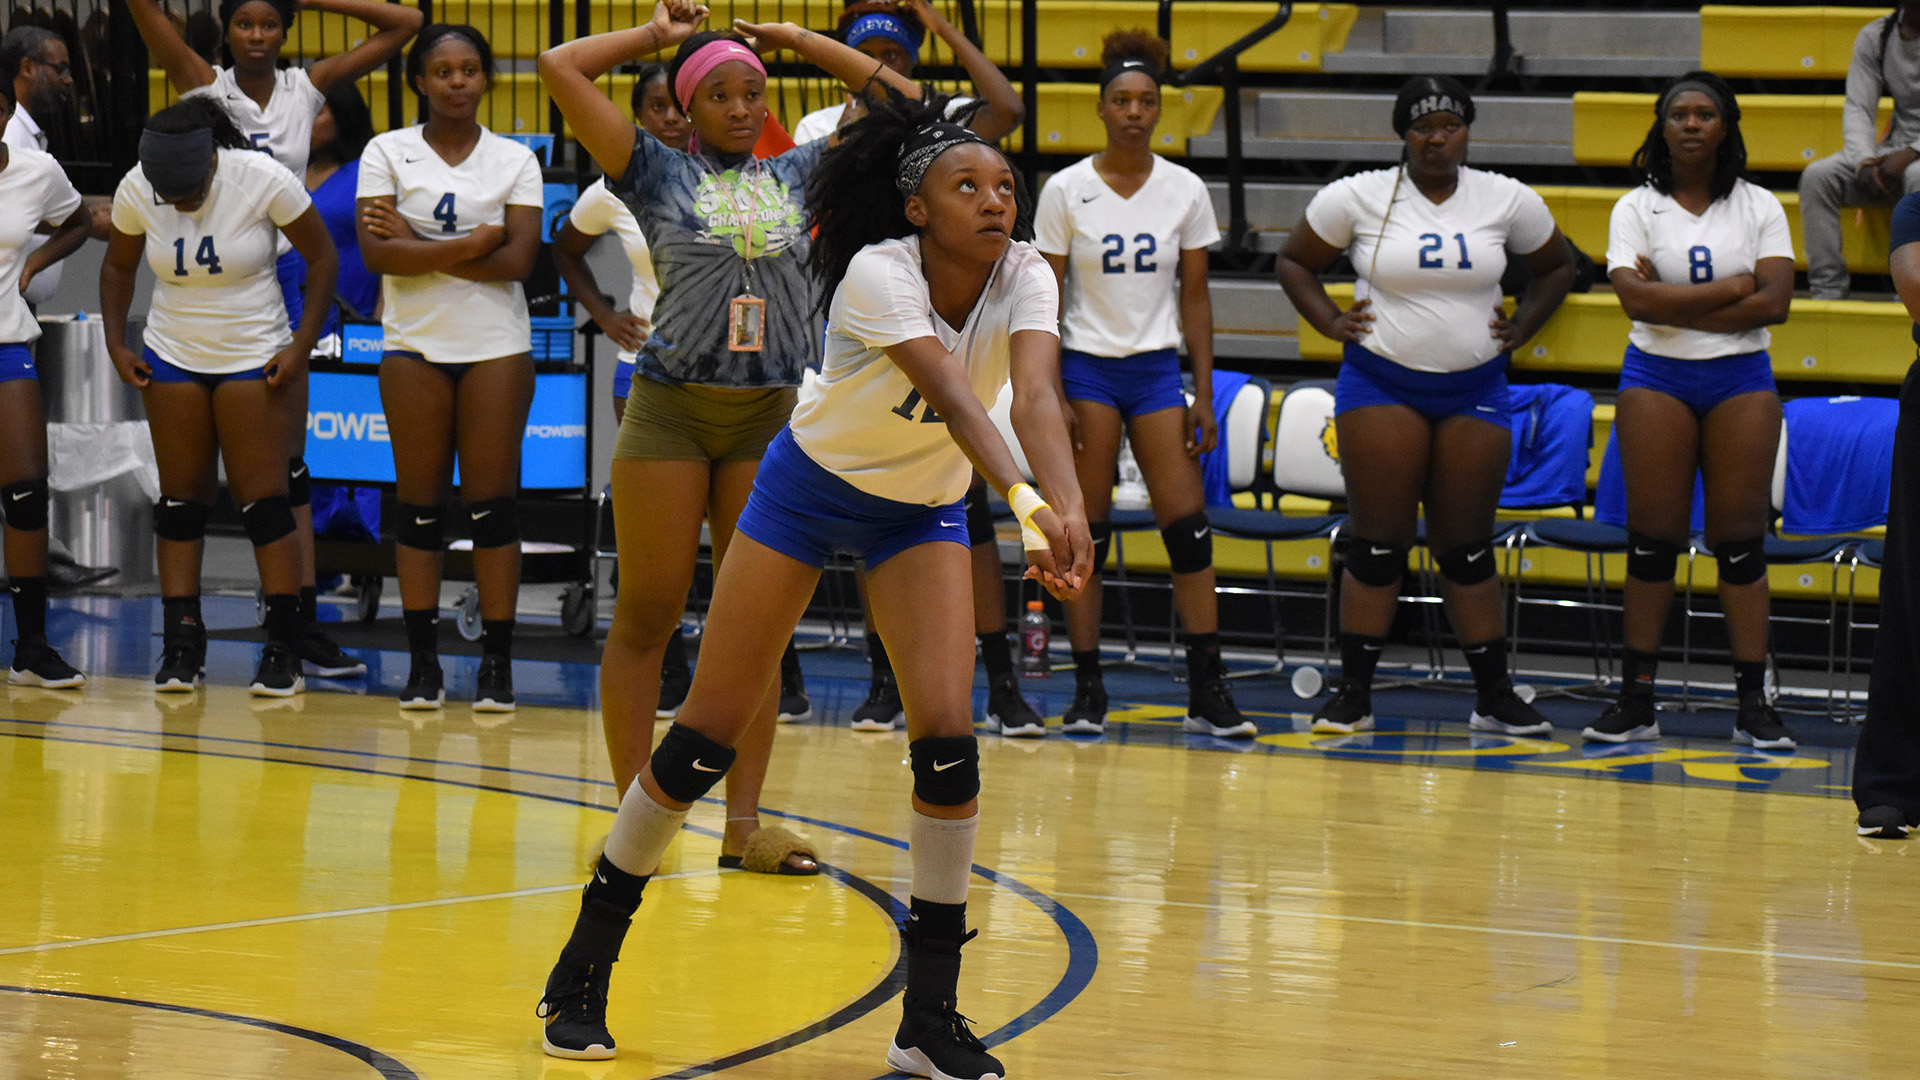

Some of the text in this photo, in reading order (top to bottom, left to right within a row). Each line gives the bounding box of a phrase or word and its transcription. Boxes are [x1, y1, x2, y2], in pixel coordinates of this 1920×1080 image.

[433, 192, 457, 232] 4
[173, 235, 223, 276] 14
[1102, 233, 1157, 274] 22
[1419, 233, 1473, 269] 21
[1688, 245, 1713, 284] 8
[891, 387, 946, 423] 1
